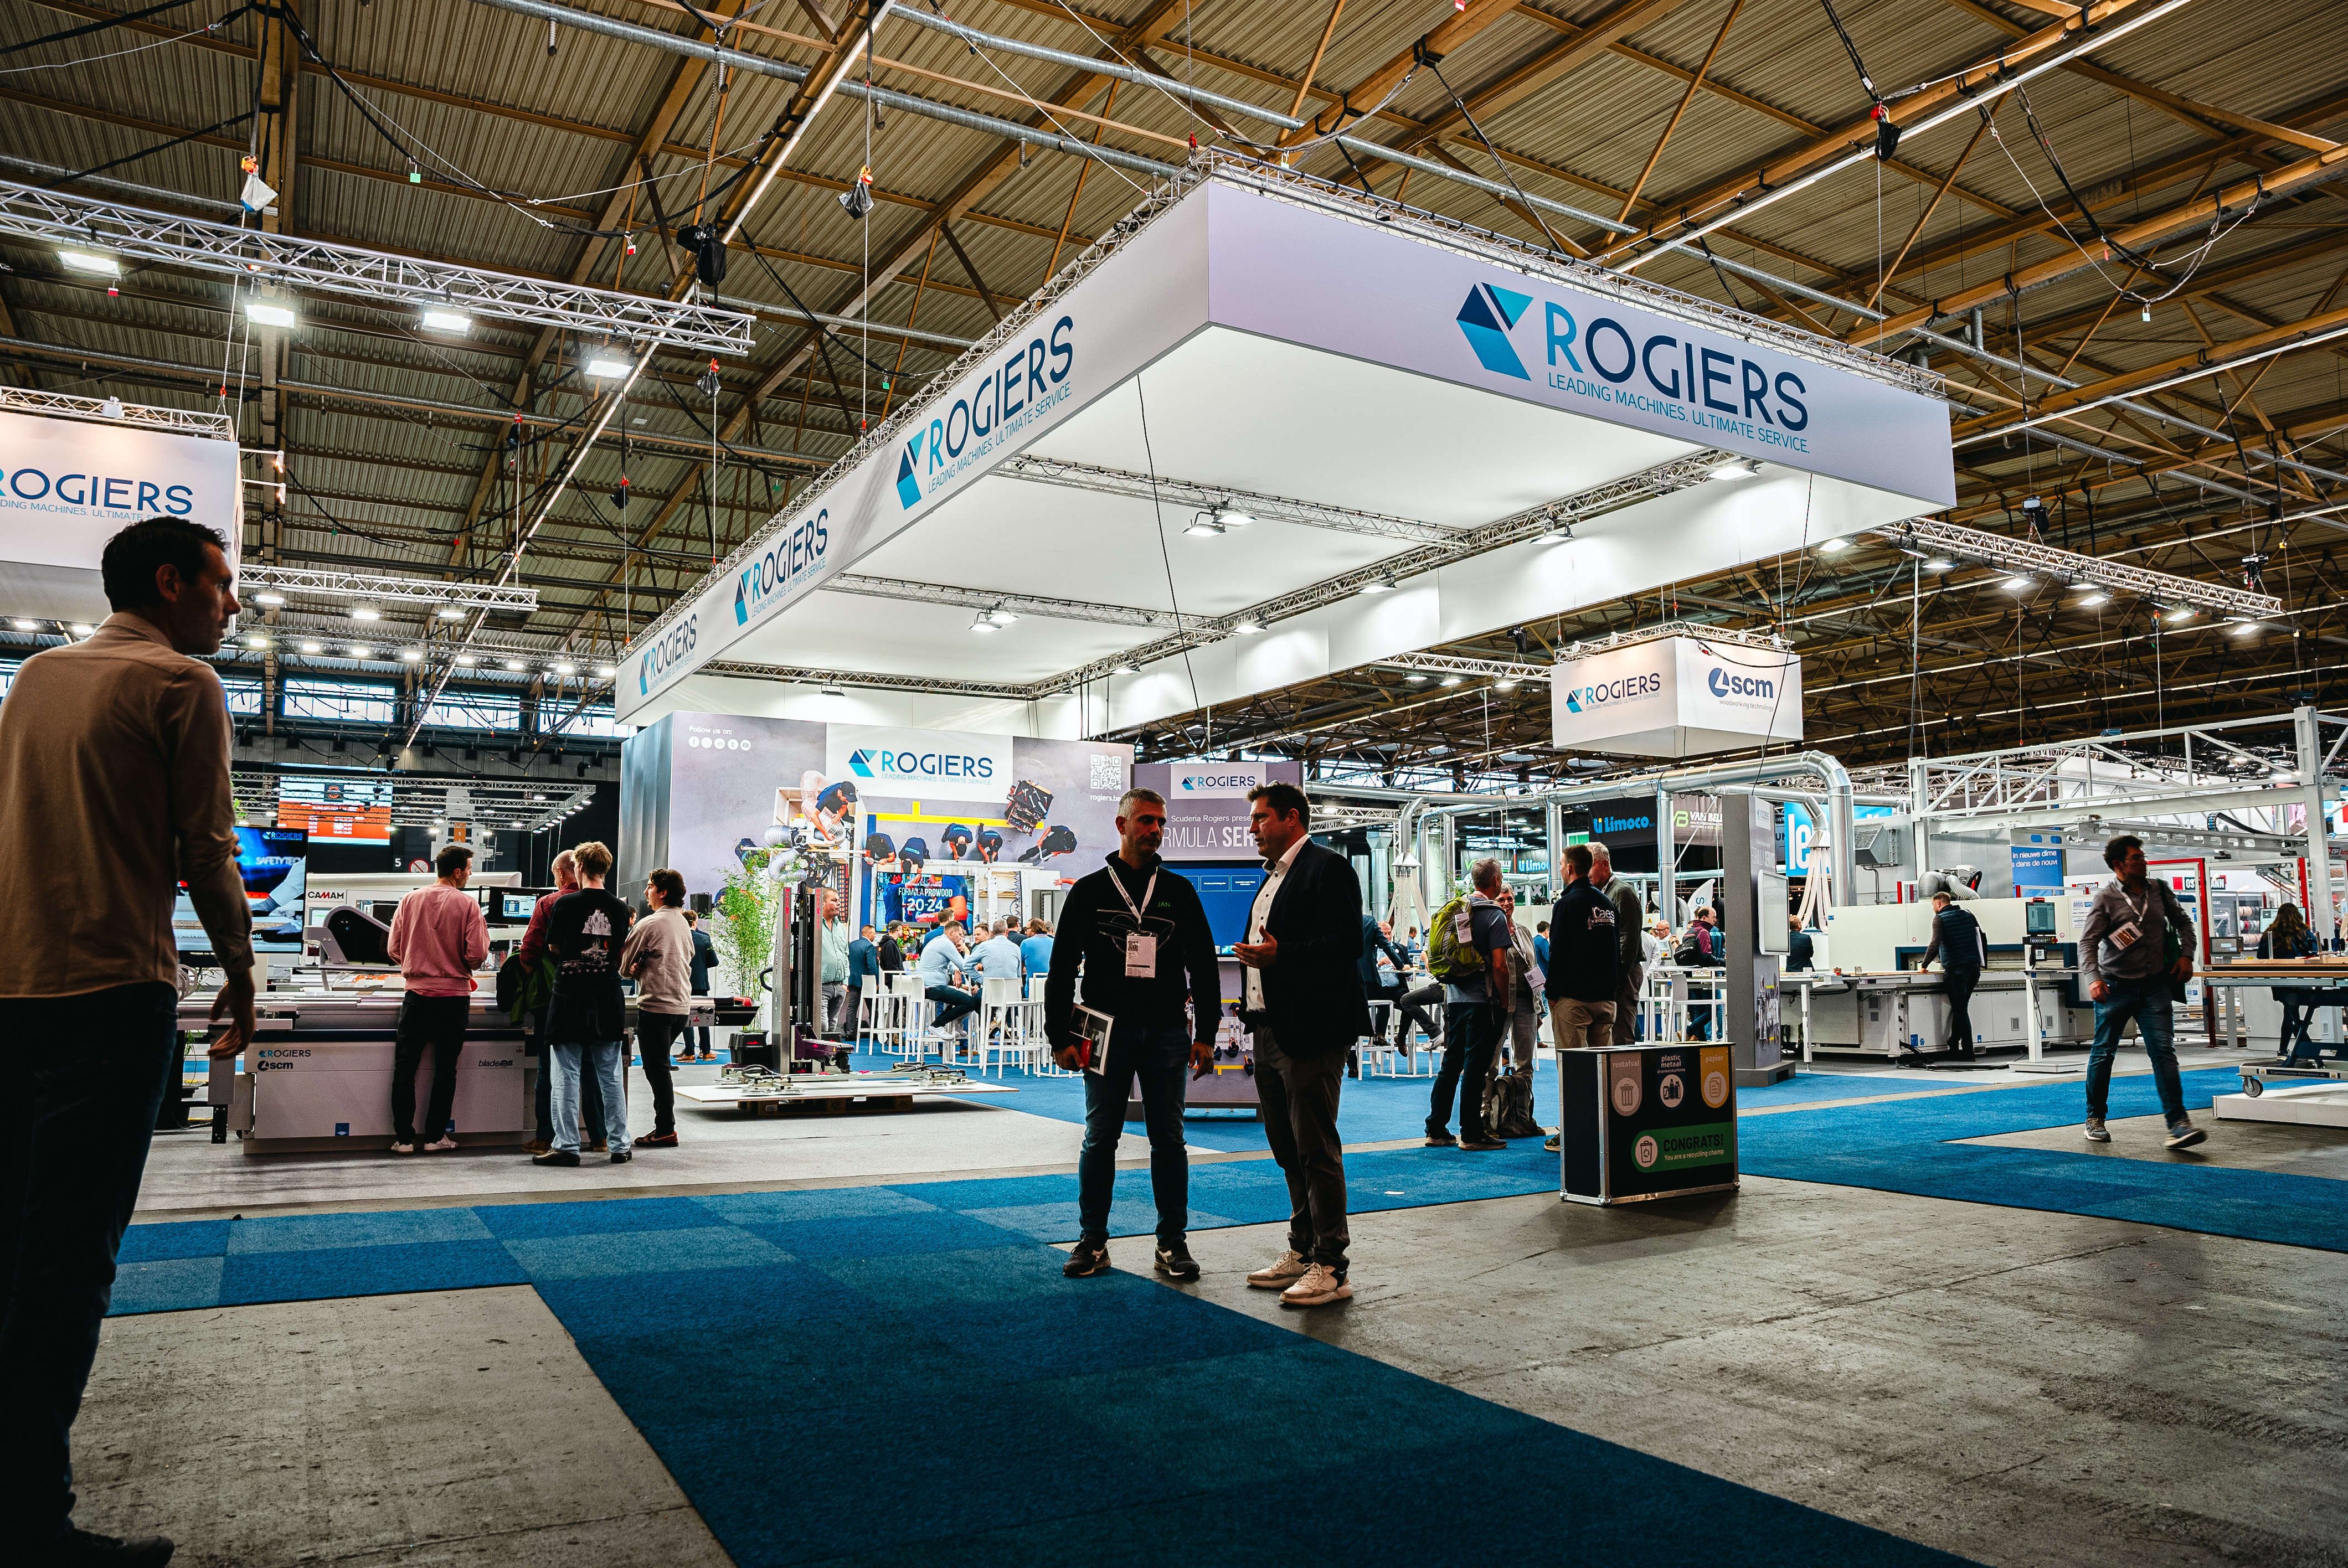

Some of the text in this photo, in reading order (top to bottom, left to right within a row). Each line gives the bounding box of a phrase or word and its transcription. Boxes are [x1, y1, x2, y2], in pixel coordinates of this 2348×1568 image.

[1545, 301, 1809, 432] ROGIERS
[929, 316, 1074, 476] ROGIERS
[1548, 372, 1810, 454] LEADING MACHINES. ULTIMATE SERVICE.
[928, 381, 1072, 494] LEADING MACHINES. ULTIMATE SERVICE.
[30, 503, 89, 517] MACHINES.
[92, 509, 143, 521] ULTIMATE
[752, 508, 828, 605] ROGIERS
[751, 599, 767, 618] LEADING
[787, 571, 807, 593] ULTIMATE
[650, 613, 697, 680] ROGIERS
[1585, 672, 1660, 705] ROGIERS
[1731, 676, 1774, 699] scm
[1623, 695, 1642, 704] ULTIMATE
[1719, 699, 1774, 712] woodworking technology
[688, 725, 710, 734] Follow
[882, 750, 993, 778] ROGIERS
[1198, 776, 1255, 787] ROGIERS
[1090, 794, 1121, 802] rogiers.be
[1203, 814, 1229, 823] Rogiers
[1690, 811, 1707, 822] VAN
[1604, 816, 1650, 832] Limoco
[395, 858, 401, 867] 5
[307, 891, 344, 899] CAMAM
[898, 887, 953, 898] FORMULA PROWOOD
[907, 898, 944, 912] 20-24
[267, 1049, 312, 1058] ROGIERS
[1661, 1054, 1681, 1063] plastic
[1705, 1055, 1724, 1063] papier
[1612, 1059, 1640, 1068] restafval
[1663, 1133, 1723, 1152] CONGRATS!
[1686, 1150, 1708, 1159] recycling
